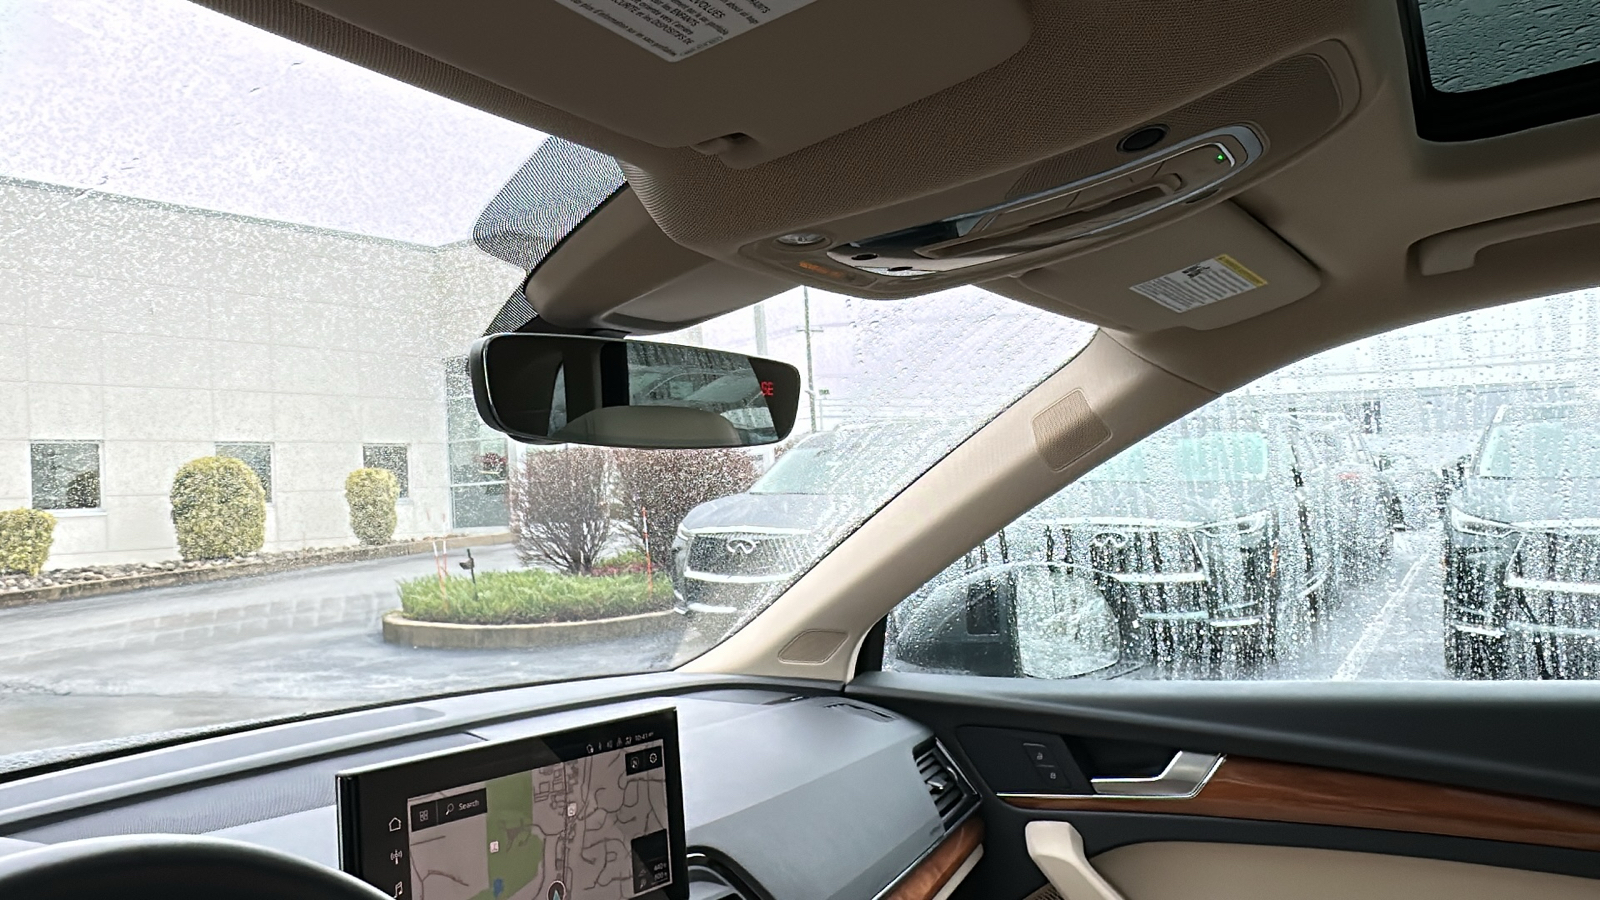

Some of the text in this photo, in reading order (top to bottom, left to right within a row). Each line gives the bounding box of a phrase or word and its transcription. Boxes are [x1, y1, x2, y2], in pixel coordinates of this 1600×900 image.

[761, 381, 773, 396] SE
[634, 733, 648, 741] 10:41
[459, 800, 480, 810] Search
